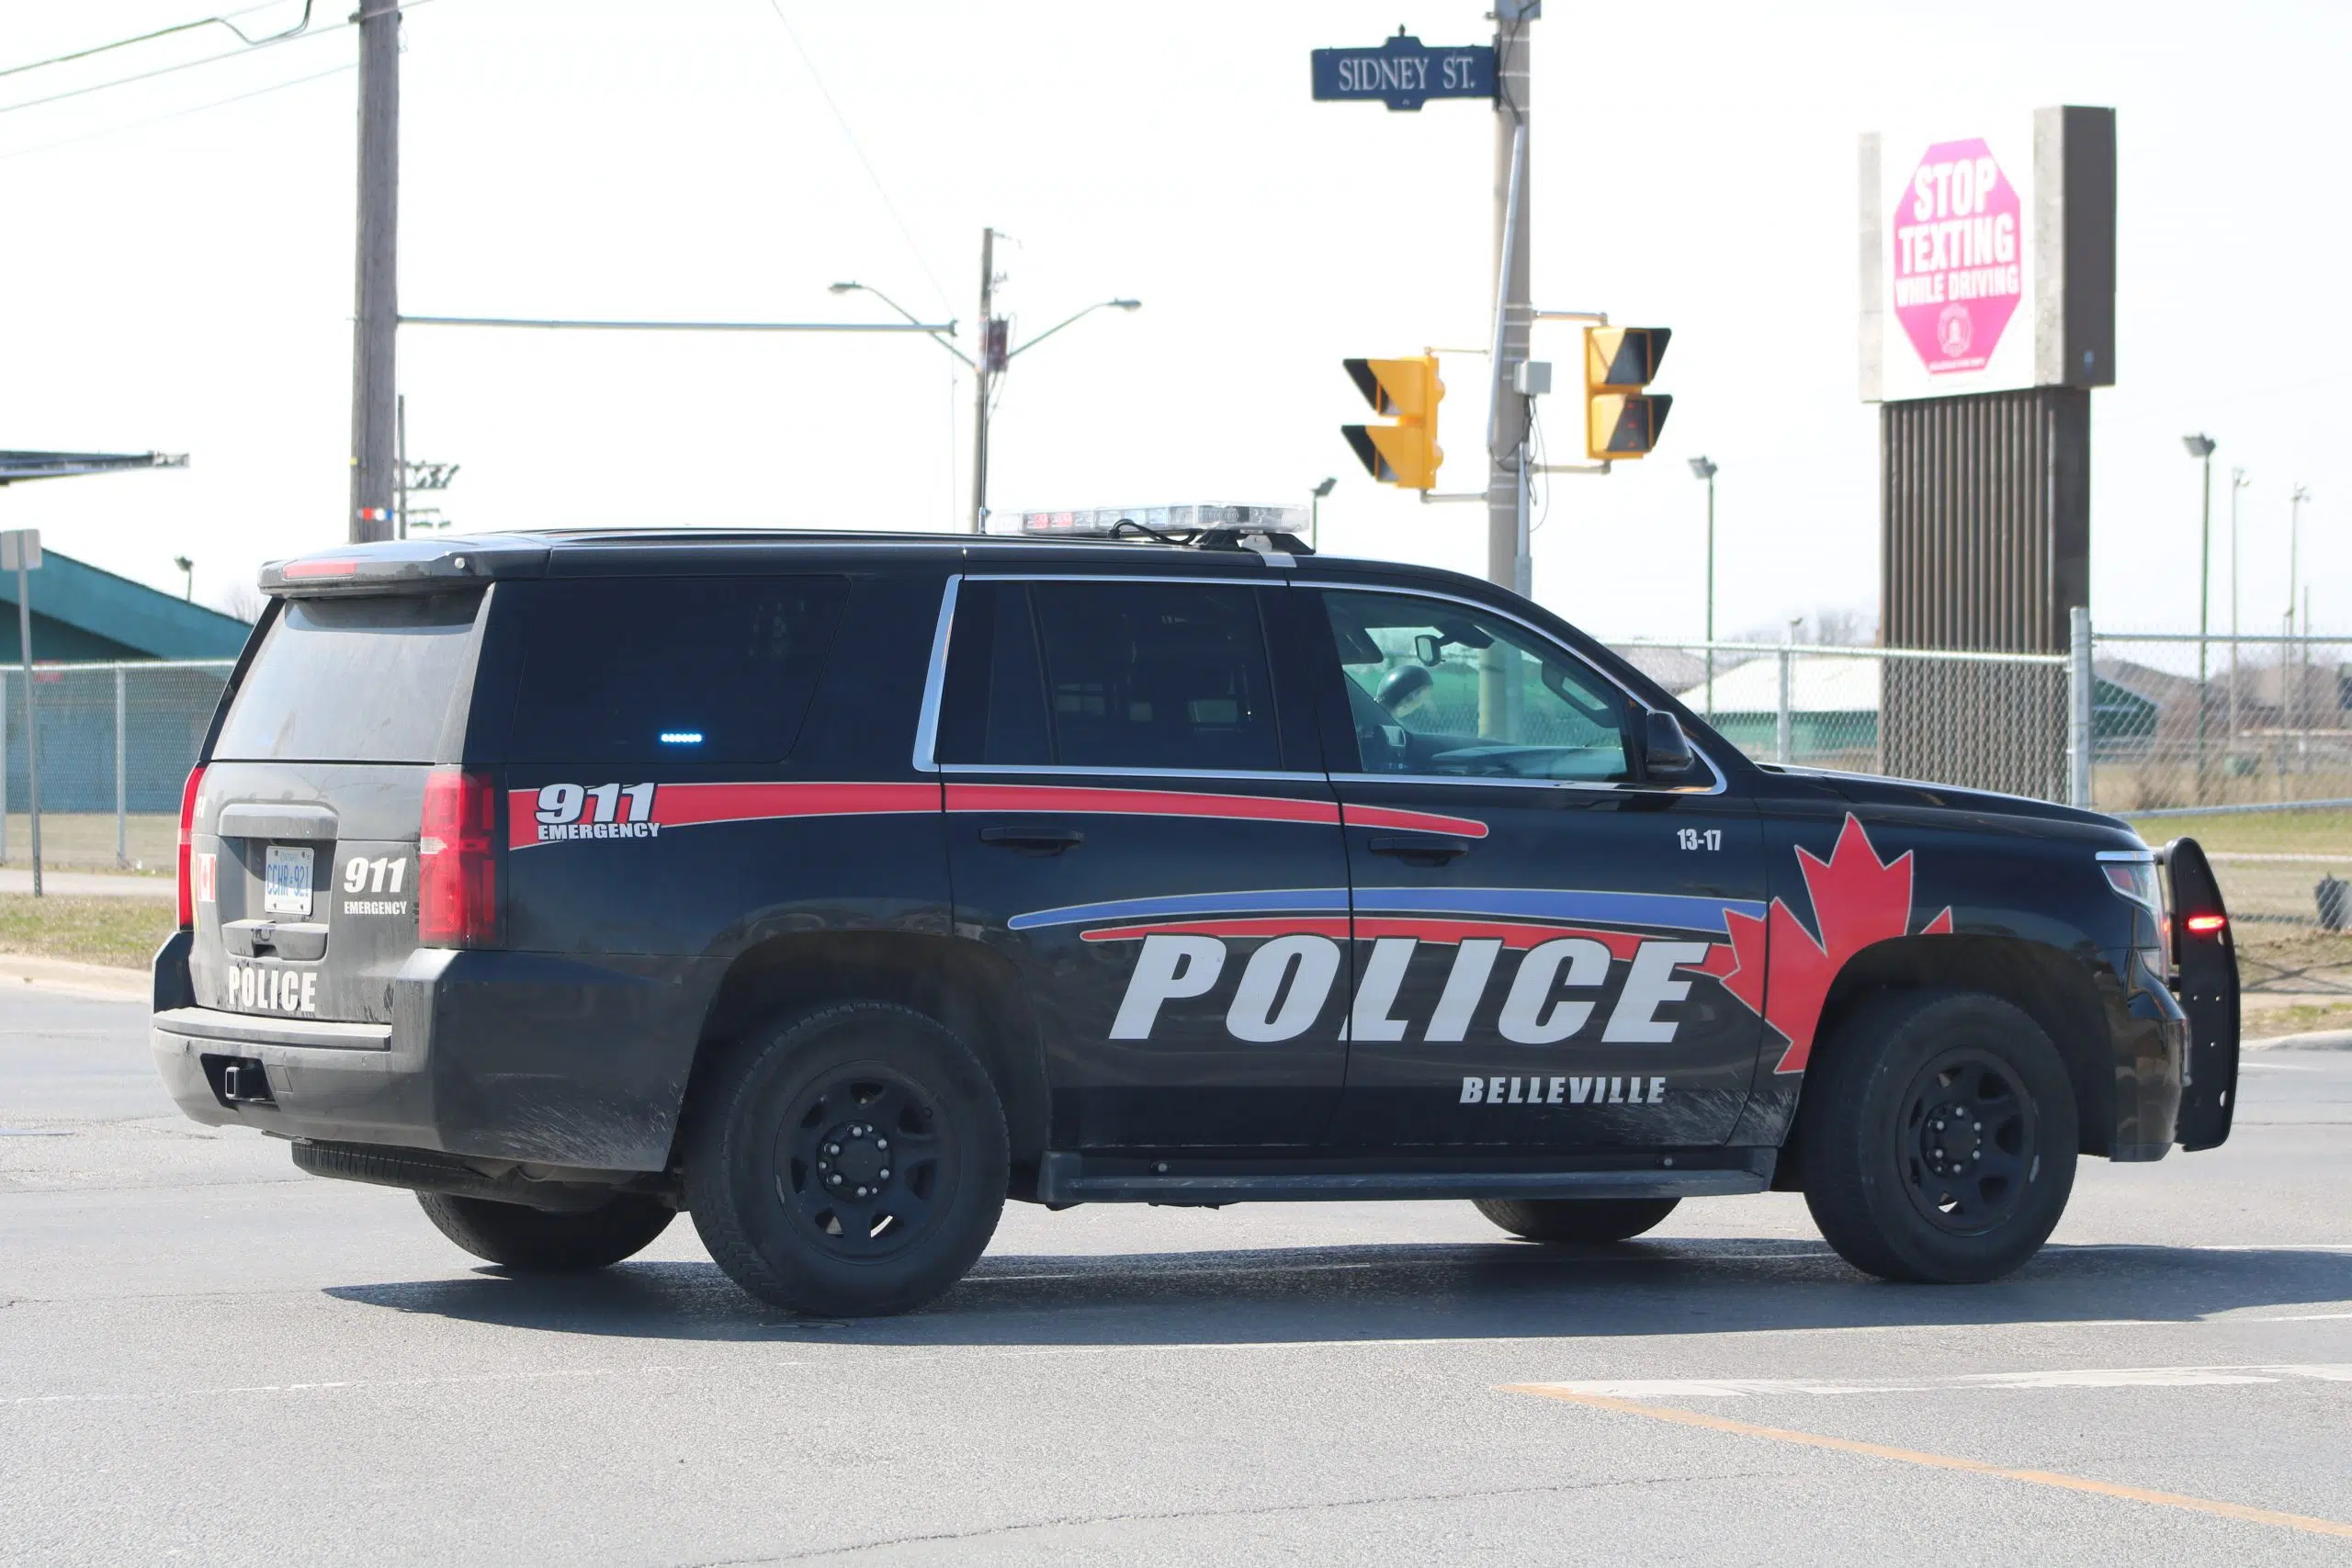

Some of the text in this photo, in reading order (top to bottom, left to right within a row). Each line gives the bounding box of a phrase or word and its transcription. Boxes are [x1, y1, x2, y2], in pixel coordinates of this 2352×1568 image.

[1339, 56, 1476, 91] SIDNEY ST.
[1914, 157, 1996, 222] STOP
[1898, 212, 2015, 275] TEXTING
[1895, 264, 2019, 308] WHILE DRIVING
[535, 783, 655, 824] 911
[537, 822, 662, 840] EMERGENCY
[1677, 829, 1721, 851] 13-17
[344, 857, 407, 893] 911
[344, 901, 408, 915] EMERGENCY
[229, 965, 317, 1011] POLICE
[1108, 934, 1709, 1043] POLICE
[1459, 1077, 1666, 1104] BELLEVILLE
